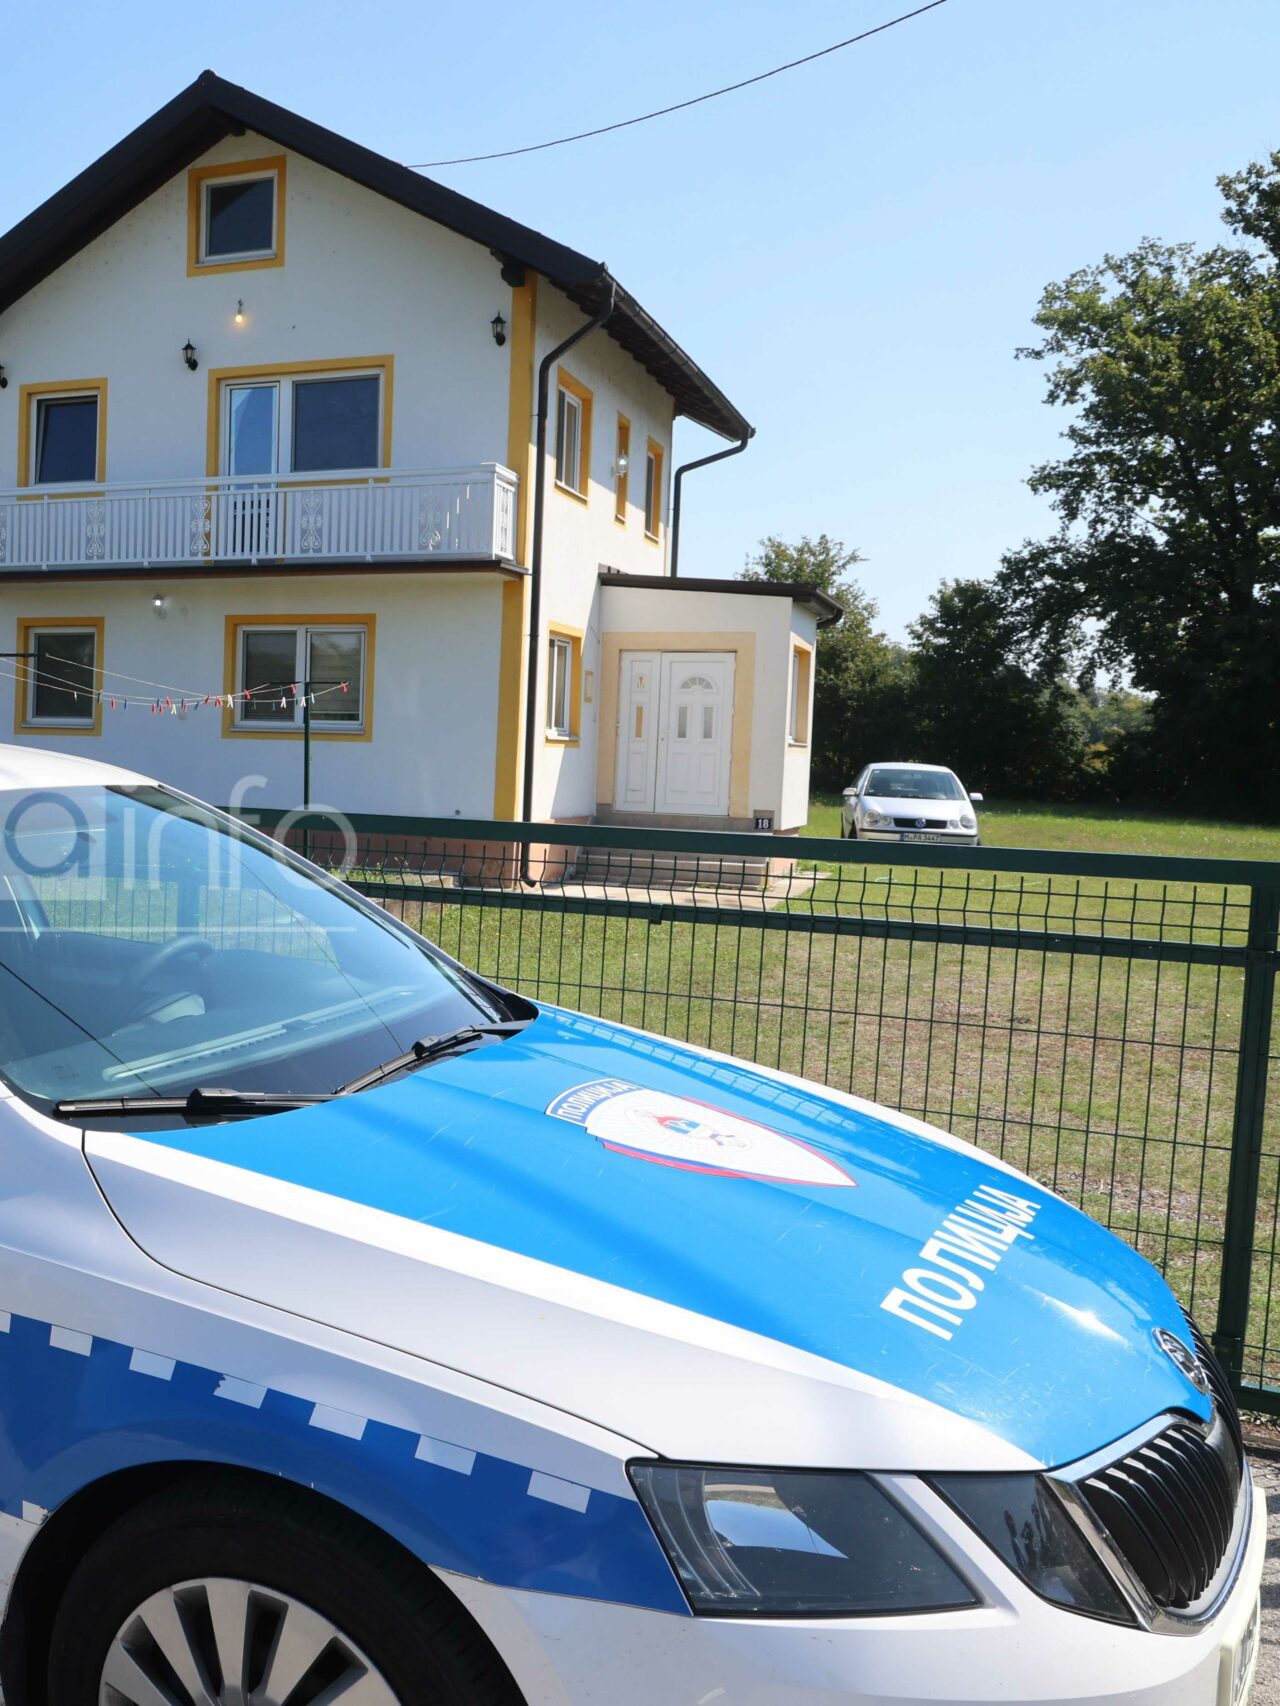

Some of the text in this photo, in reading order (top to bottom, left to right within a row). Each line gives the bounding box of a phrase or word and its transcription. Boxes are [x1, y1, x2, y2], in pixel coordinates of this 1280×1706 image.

[758, 818, 769, 829] 18
[557, 1081, 638, 1120] ПОЛИЦИЈА
[880, 1184, 1042, 1341] ПОЛИЦИЈА
